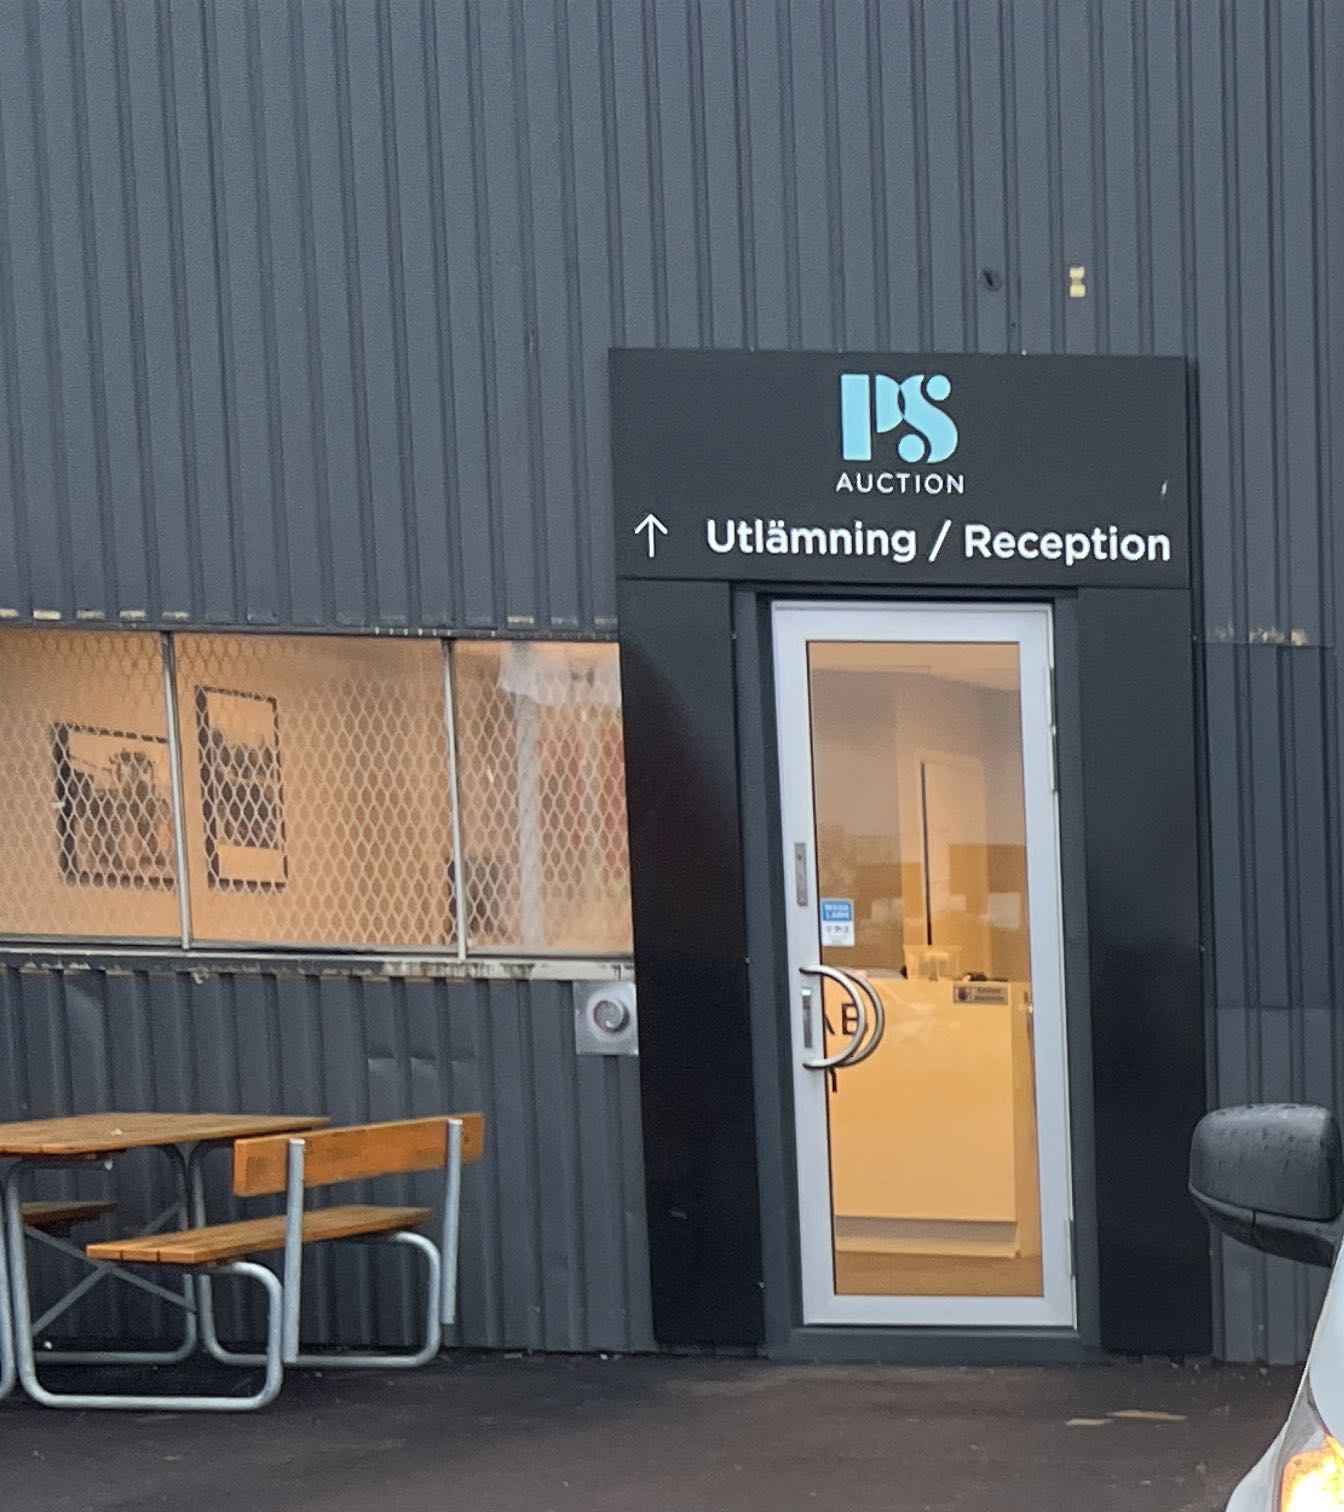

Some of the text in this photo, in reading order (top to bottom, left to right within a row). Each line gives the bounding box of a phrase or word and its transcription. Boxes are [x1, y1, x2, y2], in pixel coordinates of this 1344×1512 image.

[840, 373, 958, 464] PS
[835, 472, 965, 495] AUCTION
[706, 519, 917, 563] Utlämning
[964, 524, 1171, 567] Reception
